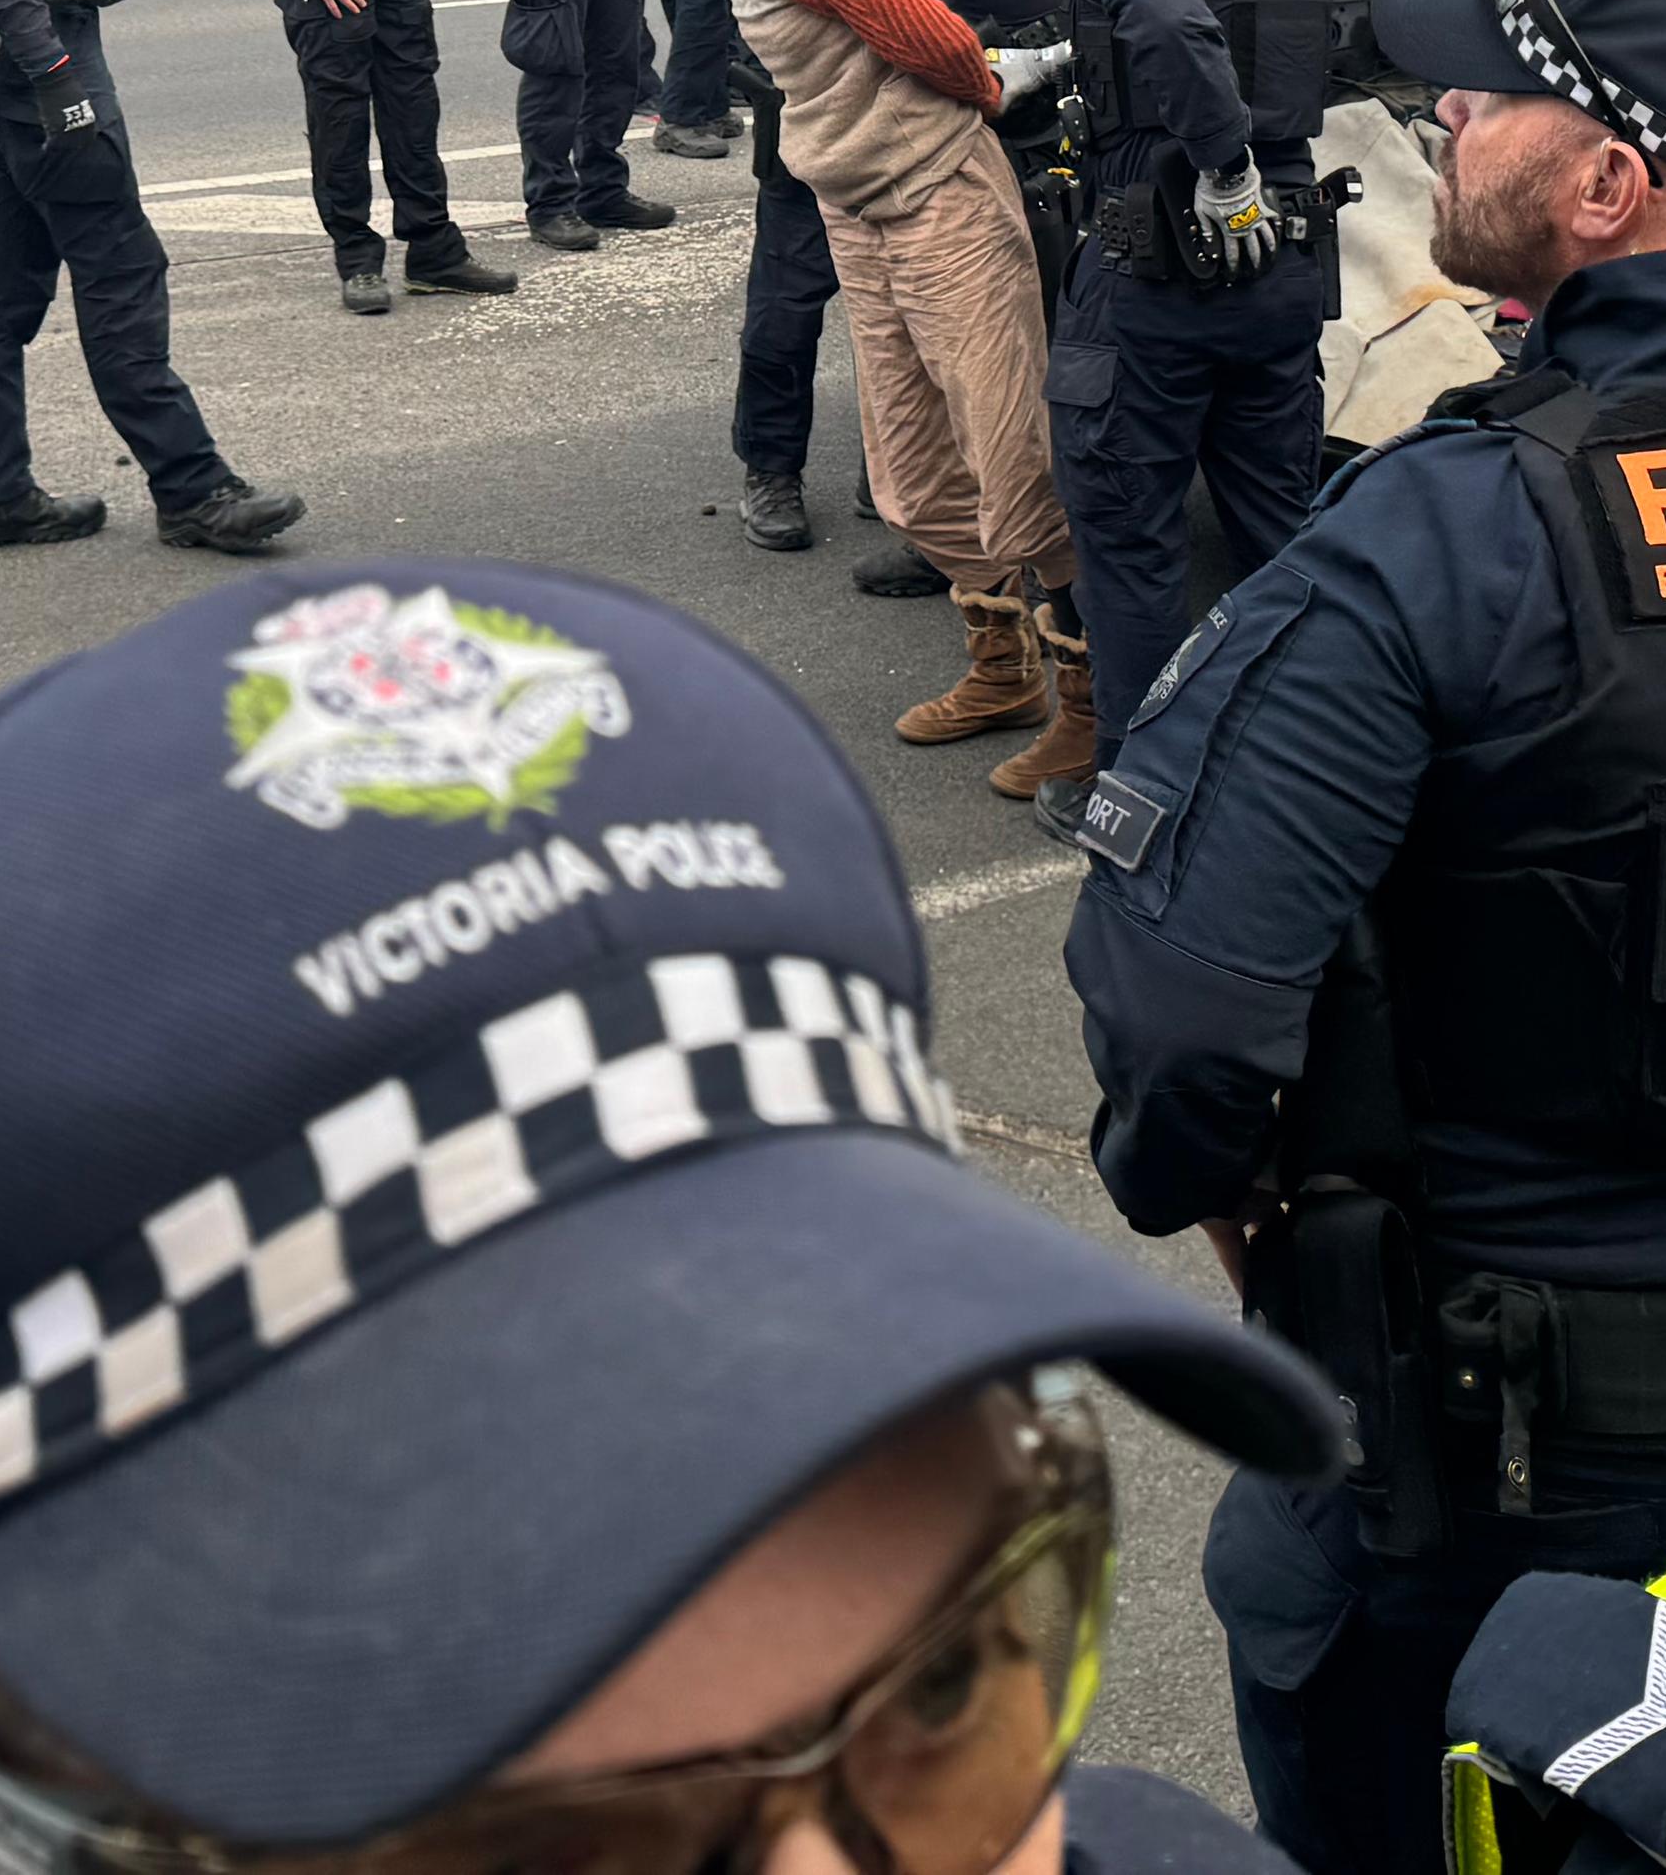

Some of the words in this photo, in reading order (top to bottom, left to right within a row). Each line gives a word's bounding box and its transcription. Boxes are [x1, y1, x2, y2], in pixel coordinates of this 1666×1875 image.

[1085, 793, 1132, 836] ORT
[293, 836, 612, 1017] VICTORIA
[600, 820, 785, 891] POLICE
